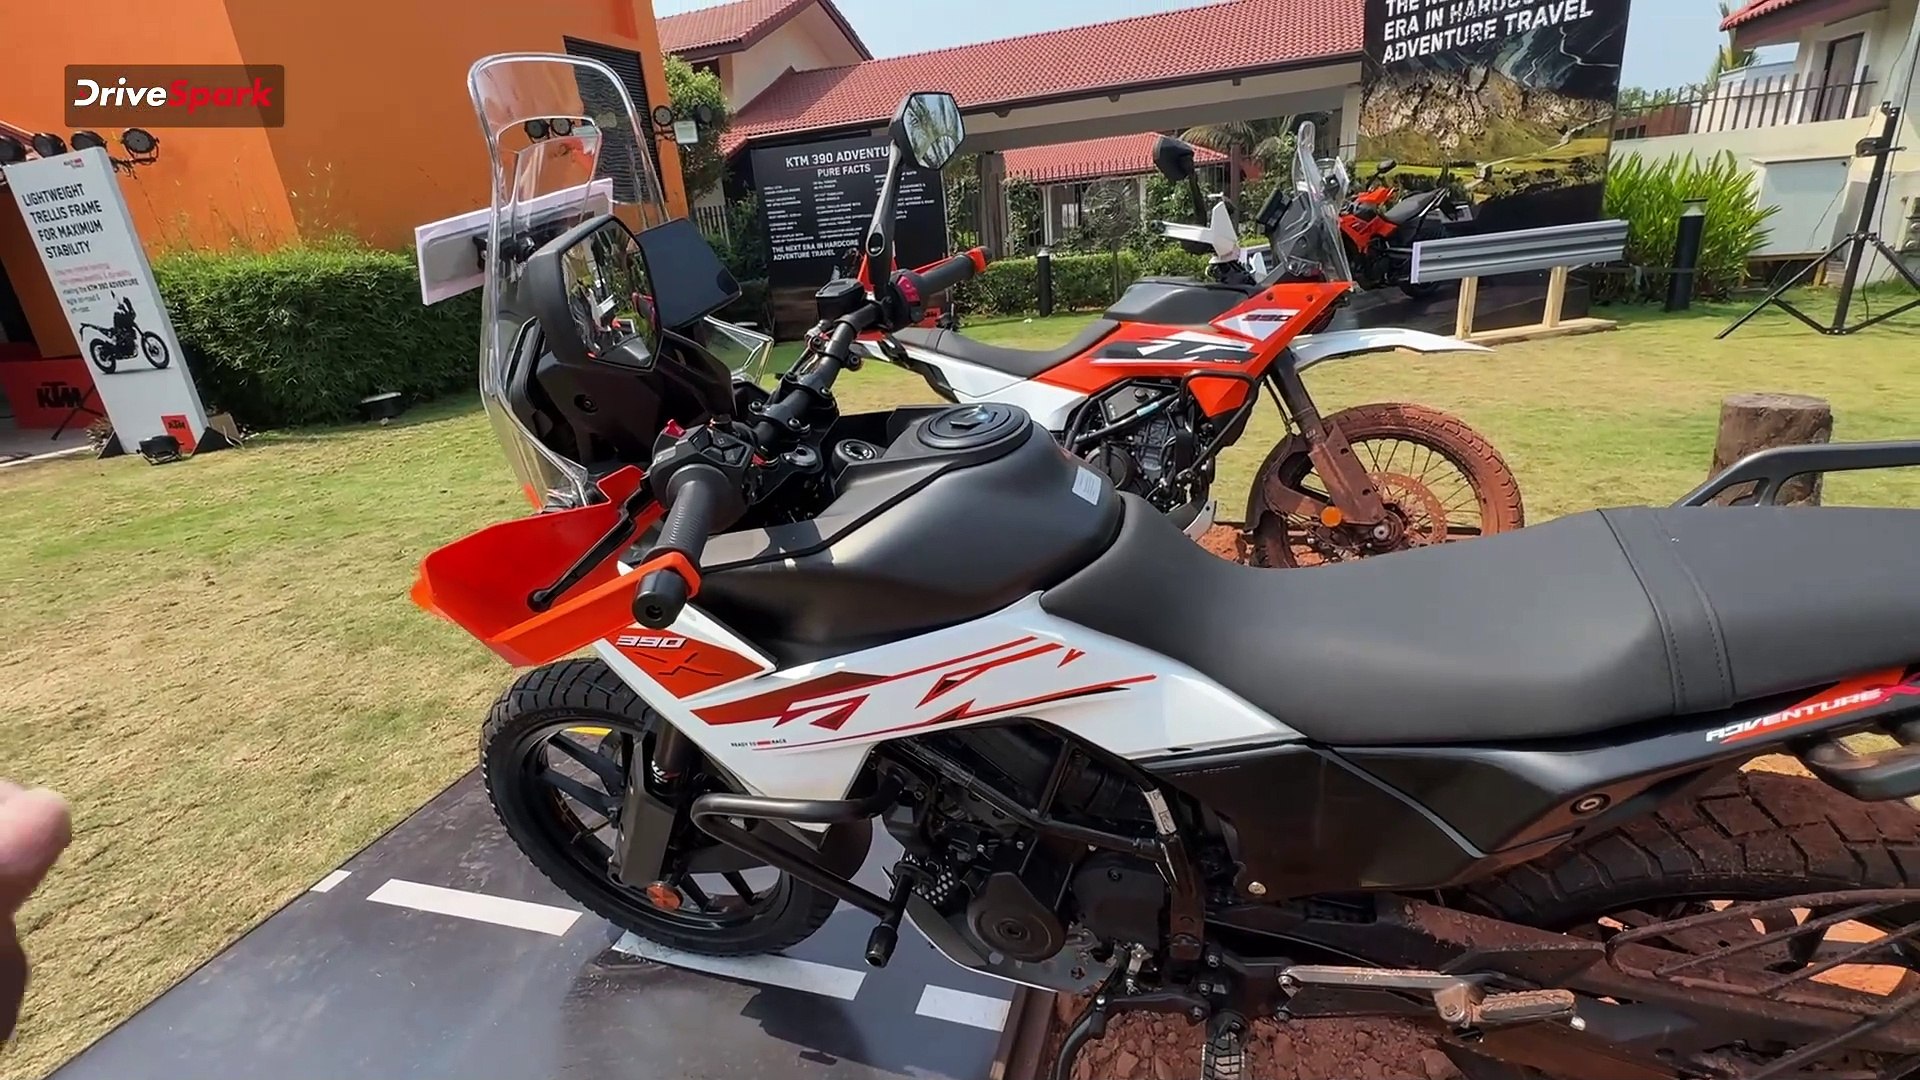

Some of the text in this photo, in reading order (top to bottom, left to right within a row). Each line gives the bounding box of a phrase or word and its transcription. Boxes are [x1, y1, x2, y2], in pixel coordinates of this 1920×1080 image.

[1382, 0, 1594, 64] ADVENTURE TRAVEL
[1384, 15, 1419, 41] ERA
[1425, 7, 1444, 31] IN
[785, 146, 890, 168] KTM 390 ADVENTU
[817, 163, 872, 178] PURE FACTS
[22, 183, 85, 207] LIGHTWEIGHT
[30, 200, 103, 224] TRELLIS FRAME
[37, 219, 104, 242] FOR MAXIMUM
[45, 240, 91, 259] STABILITY
[773, 249, 836, 261] ADVENTURE TRAVEL
[785, 244, 801, 252] NEXT
[802, 243, 815, 251] ERA
[825, 239, 859, 248] HARDCORE
[36, 382, 83, 408] KTM
[167, 419, 186, 430] KTM
[616, 635, 688, 649] 390
[1706, 688, 1884, 742] ADVENTURE
